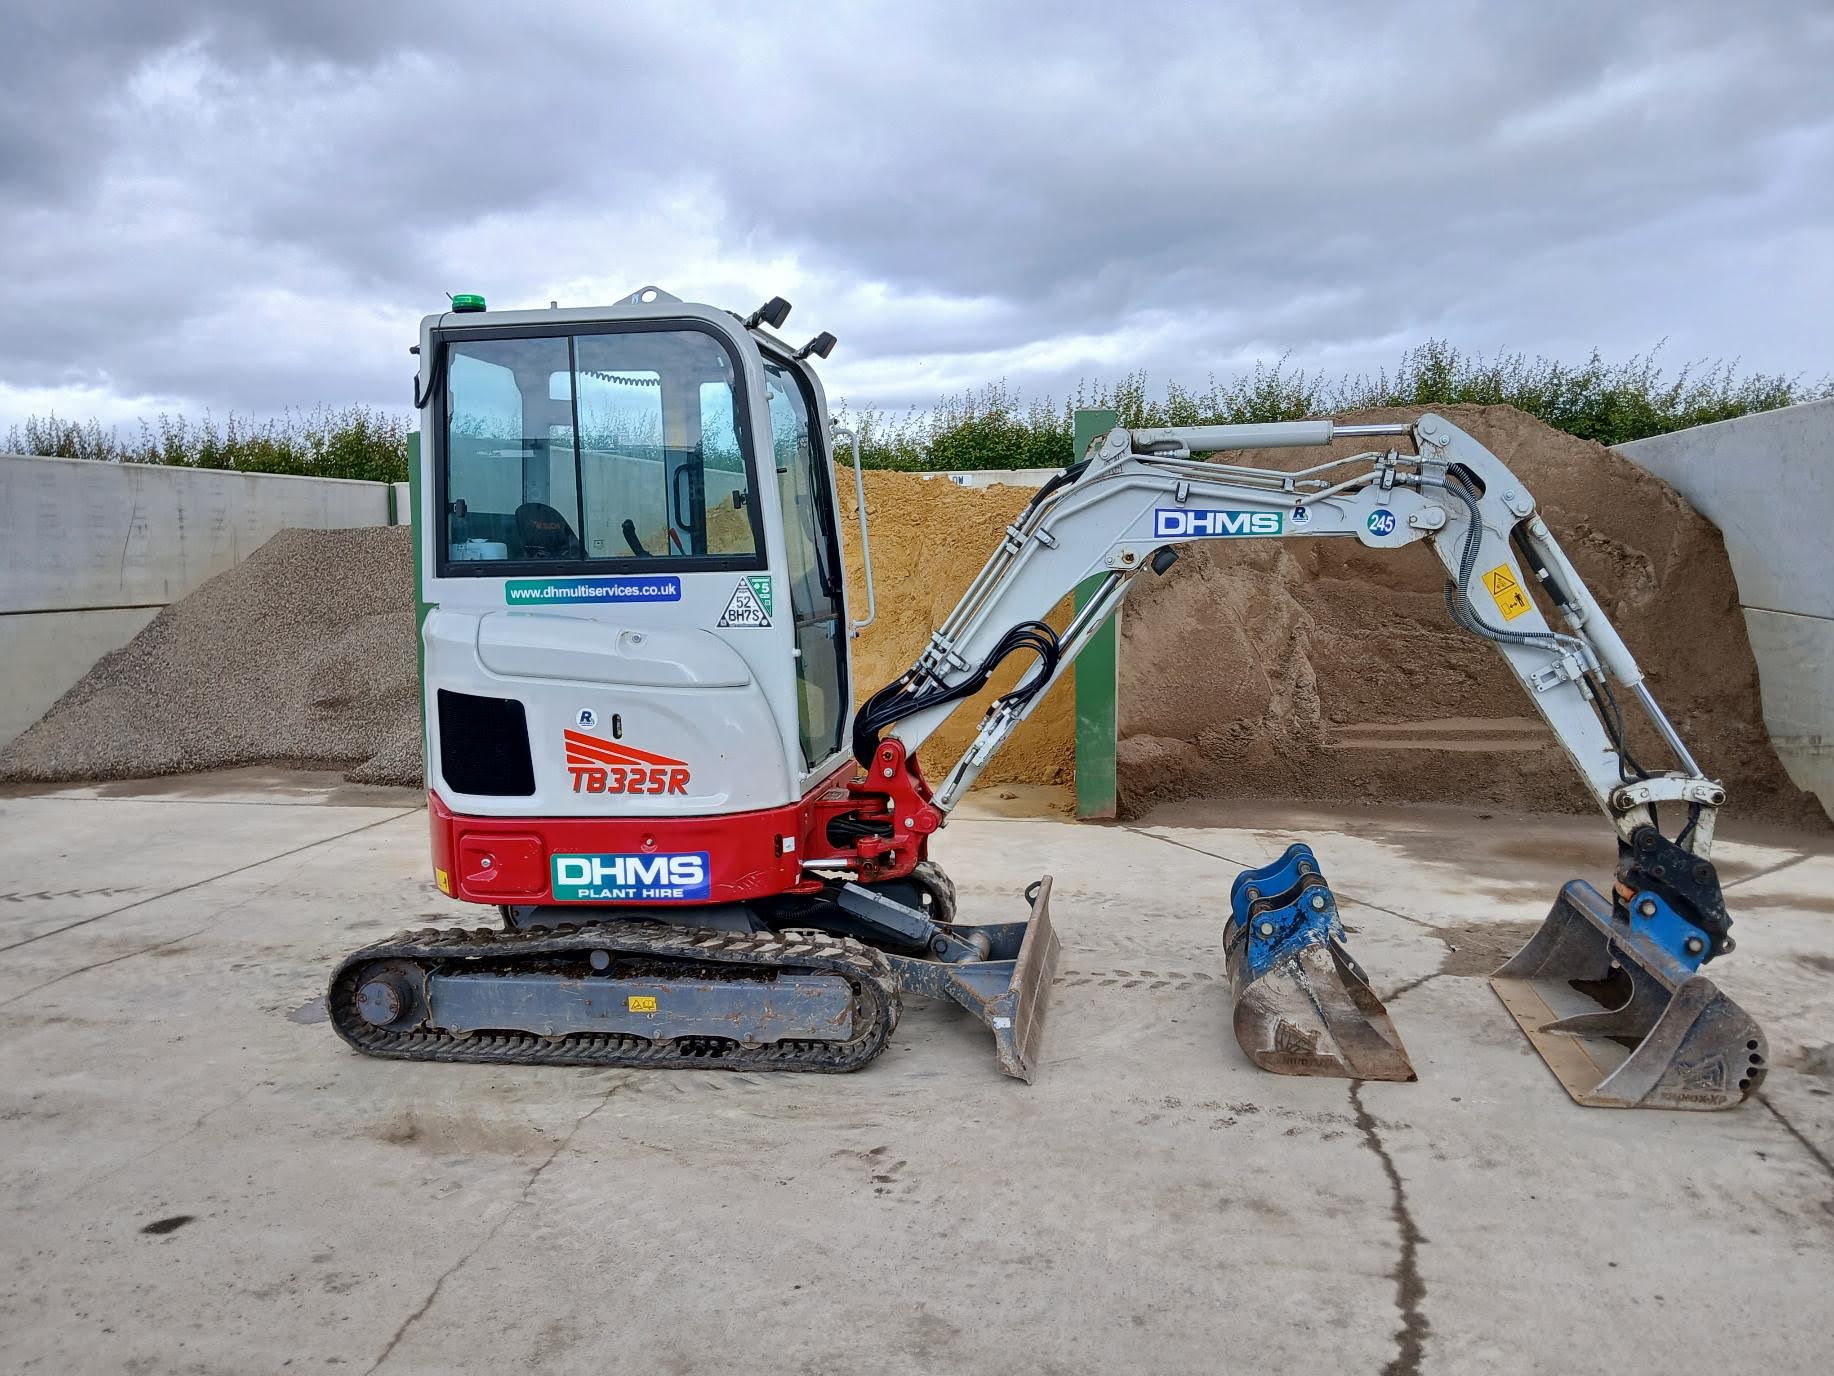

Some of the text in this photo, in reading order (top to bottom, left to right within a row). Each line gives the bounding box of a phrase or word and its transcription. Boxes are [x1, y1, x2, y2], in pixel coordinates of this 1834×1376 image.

[1156, 511, 1280, 535] DHMS
[1369, 514, 1394, 532] 245
[510, 578, 677, 599] www.dhmultiservices.co.uk
[761, 582, 770, 593] 5
[736, 596, 752, 609] 52
[567, 765, 692, 796] TB325R
[556, 855, 704, 886] DHMS
[578, 887, 684, 898] PLANT HIRE
